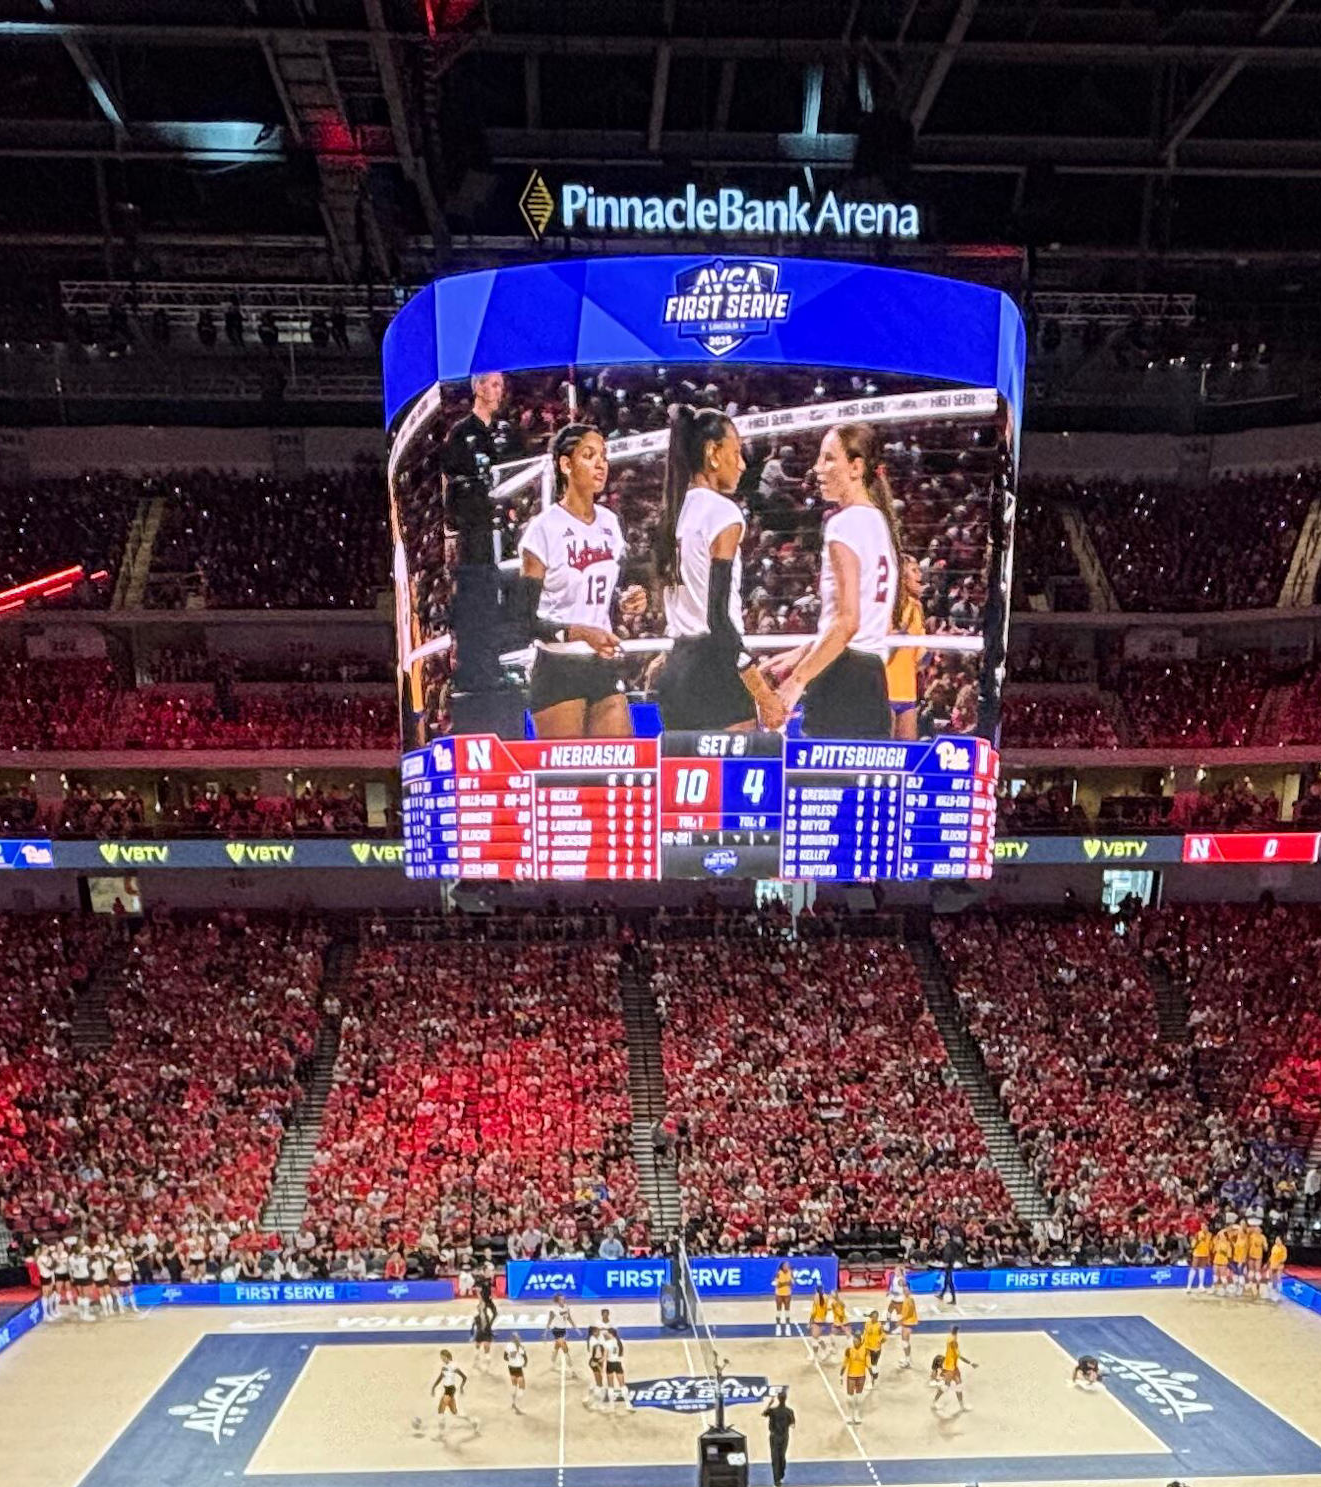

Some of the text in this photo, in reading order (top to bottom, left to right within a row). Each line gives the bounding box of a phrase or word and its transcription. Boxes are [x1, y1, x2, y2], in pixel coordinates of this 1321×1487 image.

[562, 184, 919, 236] PinnacleBank Arena
[692, 266, 761, 294] AVCA
[664, 292, 790, 322] FIRST SERVE
[585, 575, 607, 605] 12
[466, 740, 493, 770] N
[540, 745, 636, 767] 1 NEBRASKA
[698, 734, 731, 756] SET
[797, 745, 908, 769] 3 PITTSBURGH
[675, 768, 765, 804] 10 4
[120, 844, 169, 863] VBTV
[246, 844, 295, 863] VBTV
[1102, 839, 1148, 858] VBTV
[1189, 836, 1212, 859] N
[525, 1273, 576, 1290] AVCA
[606, 1268, 665, 1288] FIRST
[1006, 1272, 1100, 1287] FIRST SERVE
[235, 1285, 335, 1301] FIRST SERVE
